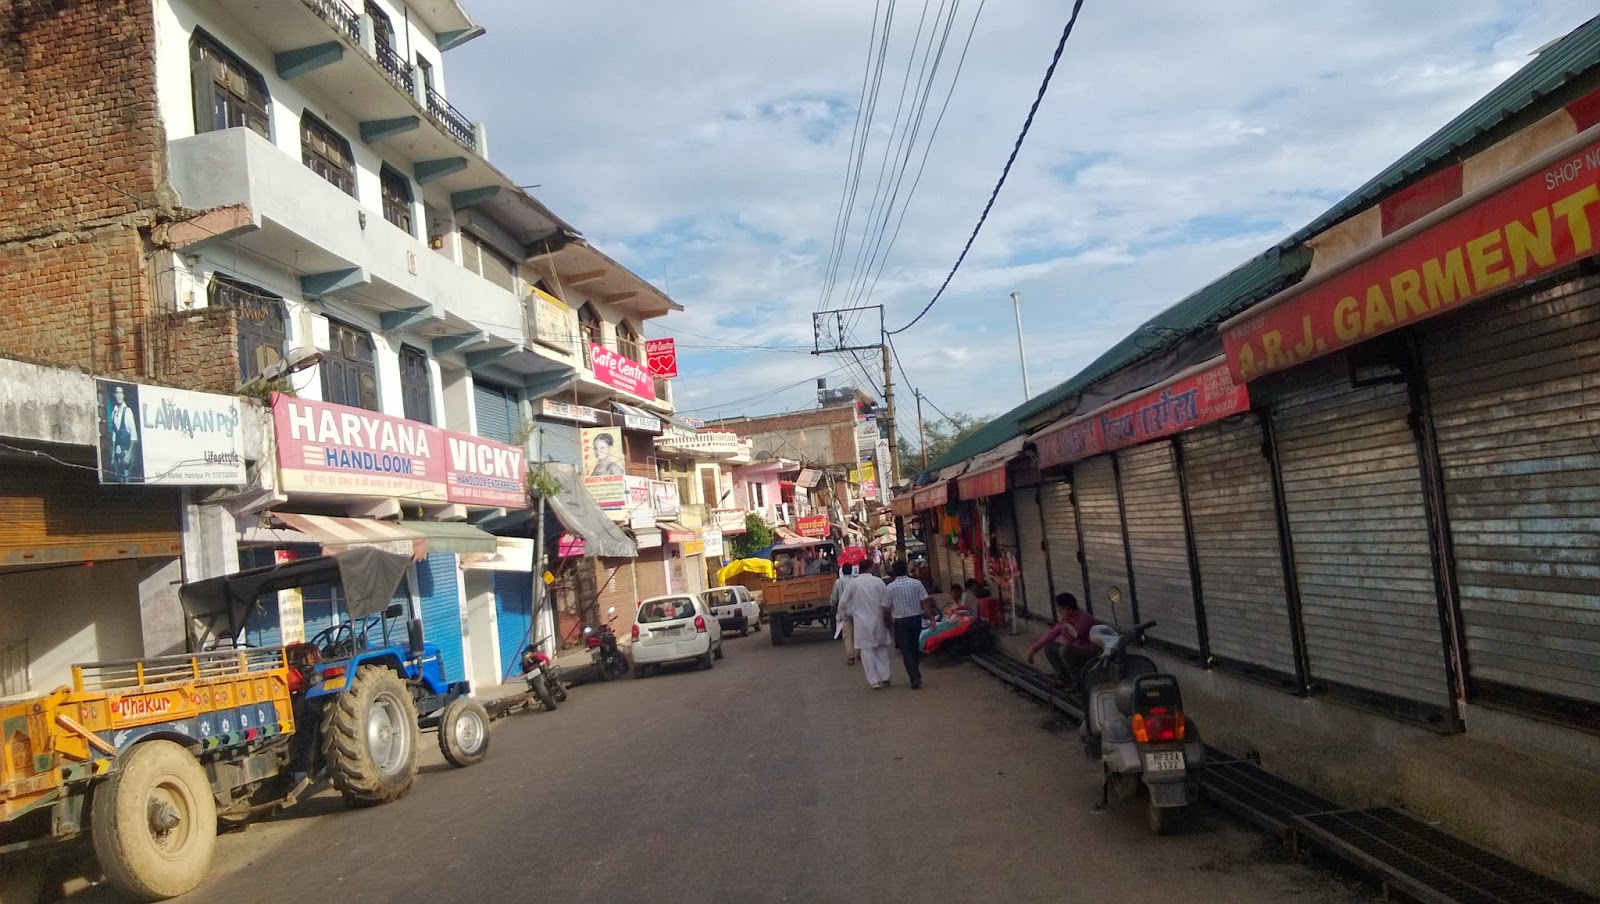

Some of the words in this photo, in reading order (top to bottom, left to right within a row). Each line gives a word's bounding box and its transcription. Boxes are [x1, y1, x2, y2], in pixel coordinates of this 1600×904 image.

[1545, 158, 1583, 190] SHOP
[1334, 183, 1600, 344] GARMENT
[592, 346, 617, 369] Cafe
[142, 399, 214, 439] LAWMAN
[288, 403, 431, 458] HARYANA
[325, 447, 412, 475] HANDLOOM
[449, 437, 521, 480] VICKY
[118, 695, 171, 717] Thakur
